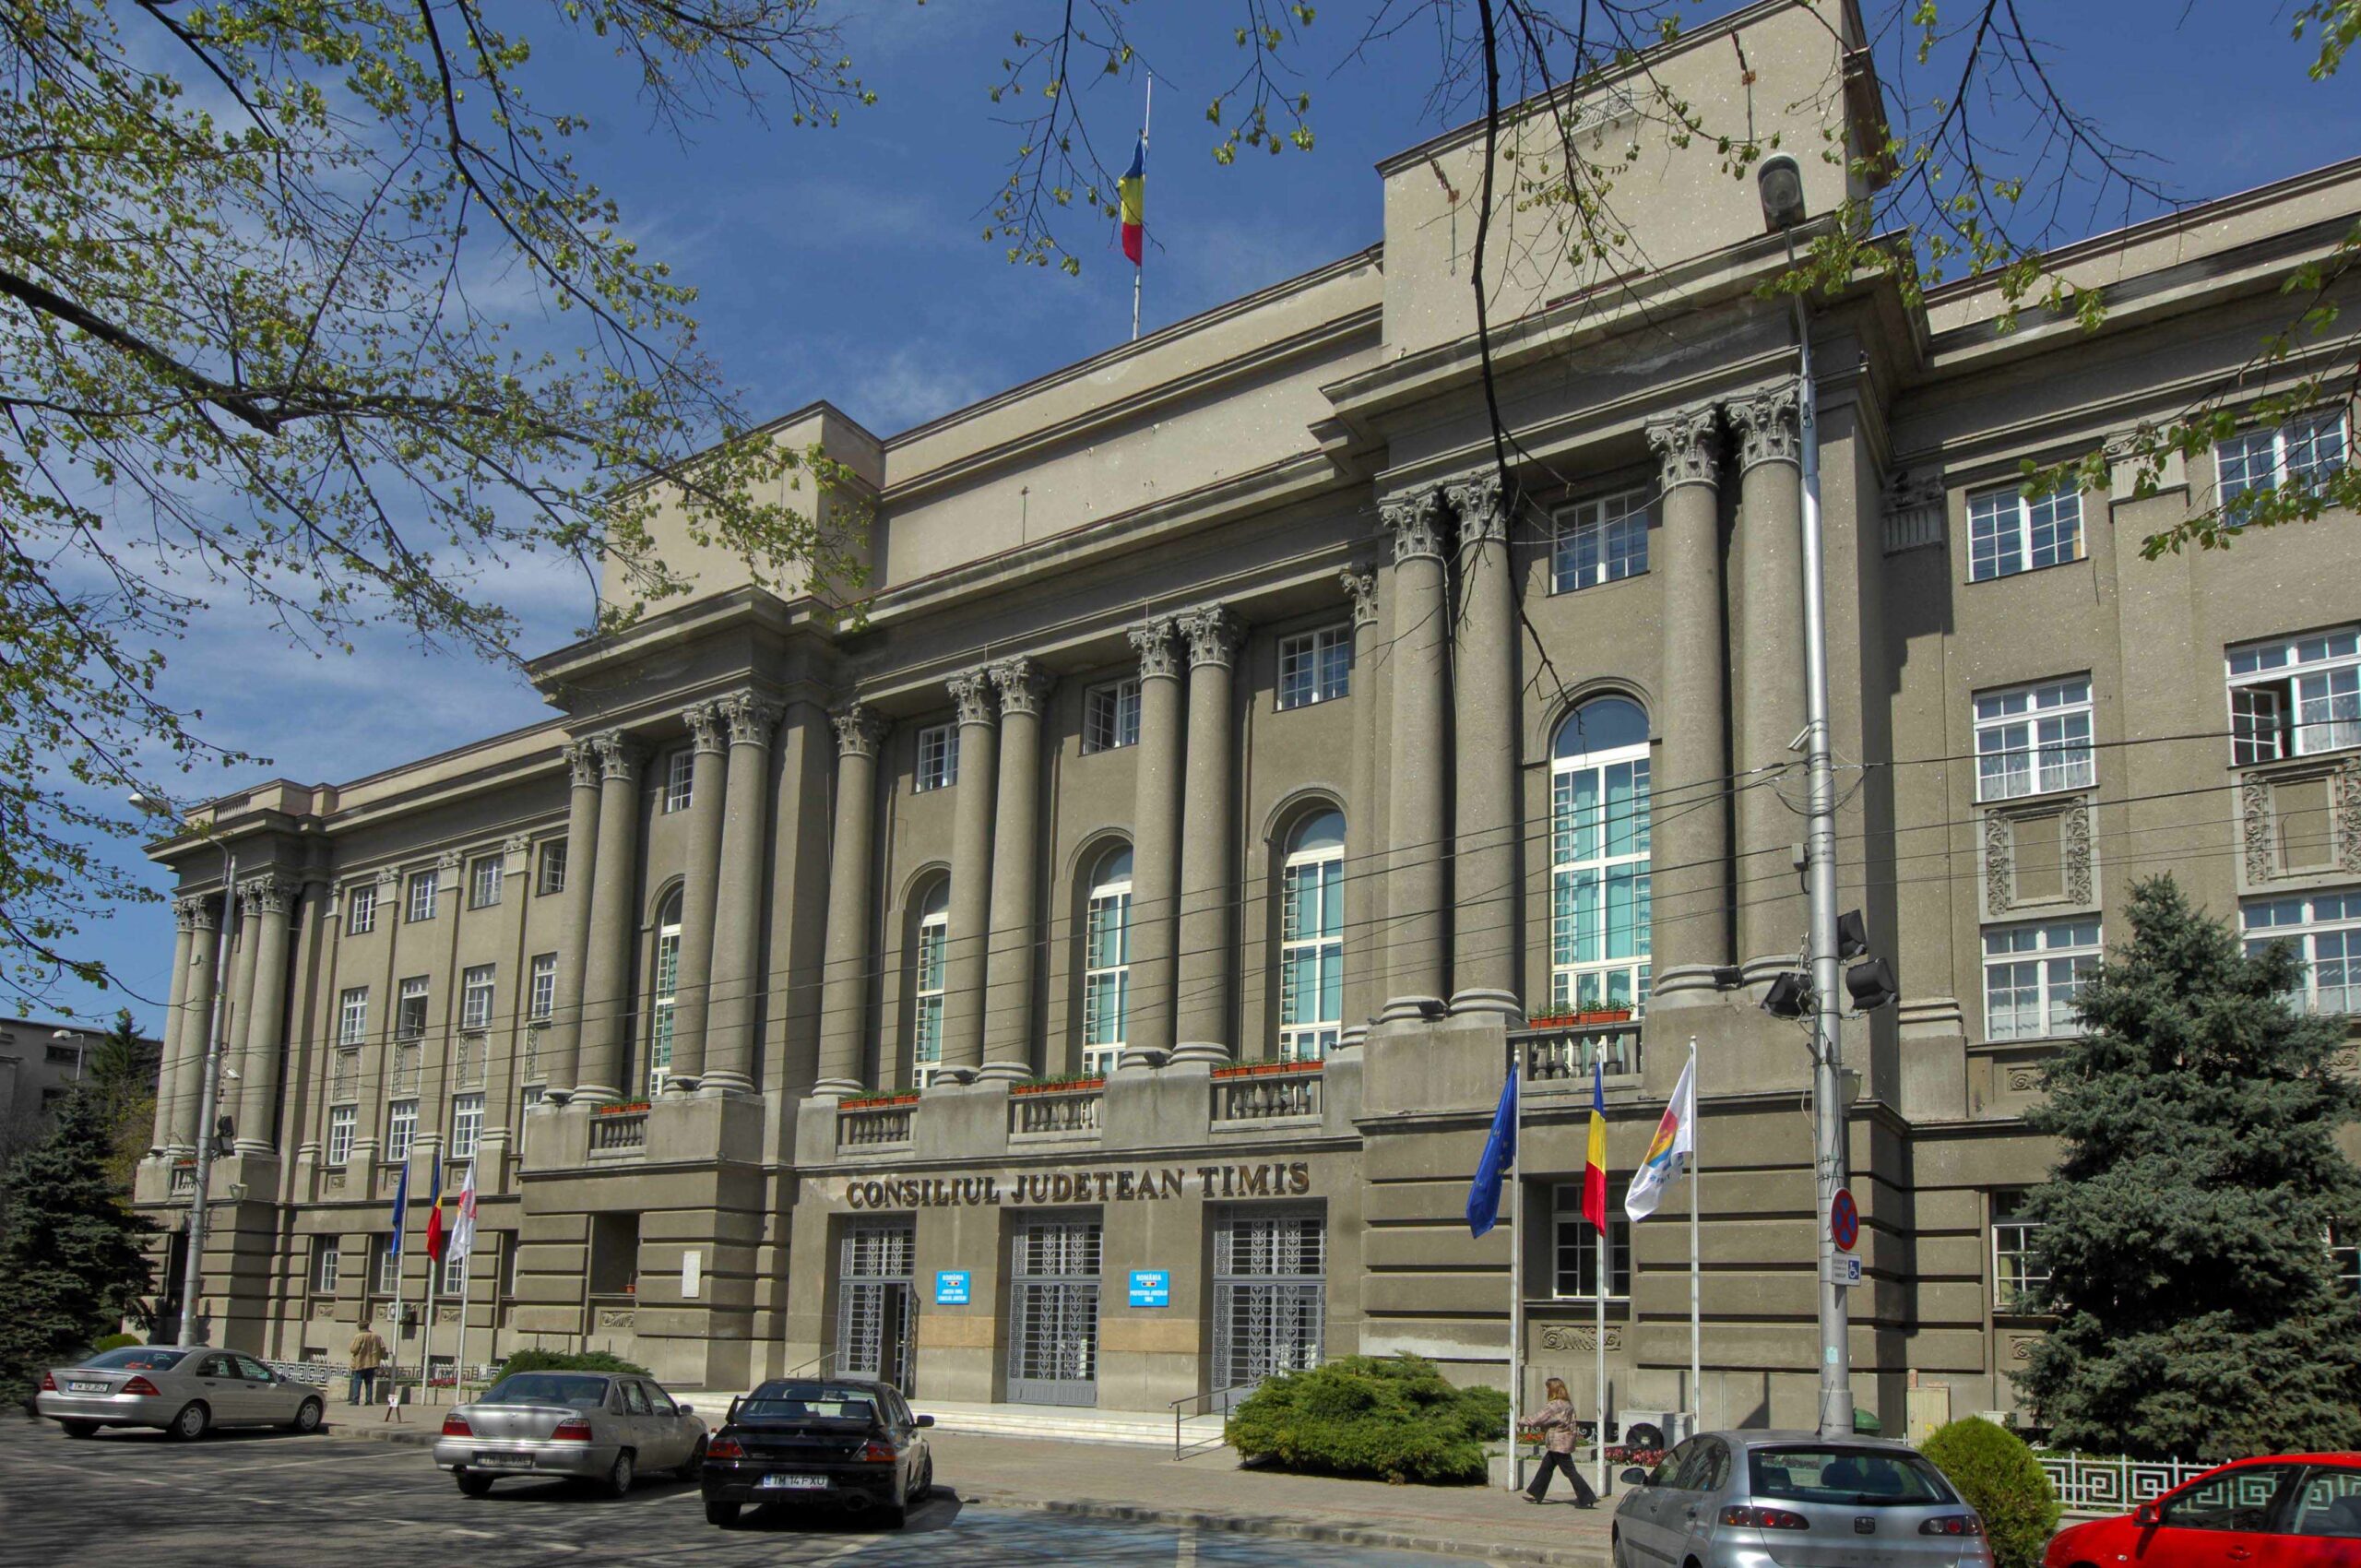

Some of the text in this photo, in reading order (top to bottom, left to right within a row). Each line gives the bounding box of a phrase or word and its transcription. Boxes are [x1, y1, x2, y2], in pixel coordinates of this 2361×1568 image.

[846, 1162, 1310, 1209] CONSILIUL JUDETEAN TIMIS
[772, 1476, 786, 1485] TM
